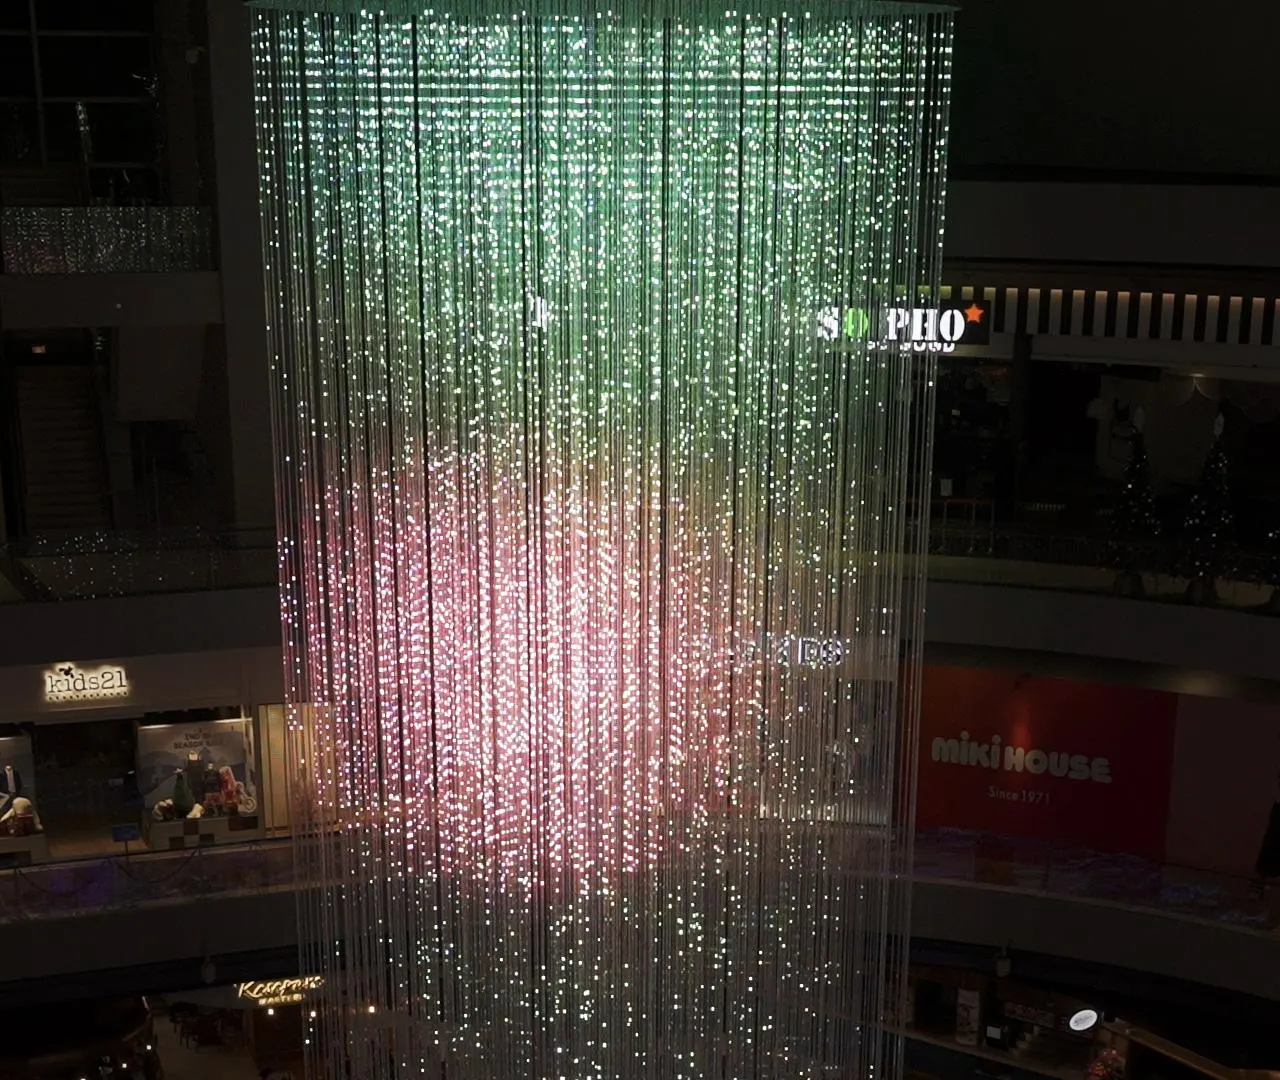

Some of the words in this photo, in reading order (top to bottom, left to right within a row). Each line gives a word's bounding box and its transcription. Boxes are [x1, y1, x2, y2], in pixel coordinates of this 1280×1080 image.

[886, 307, 966, 342] PHO
[46, 668, 129, 694] kids21
[1003, 745, 1114, 784] HOUSE
[1021, 789, 1051, 806] 1971
